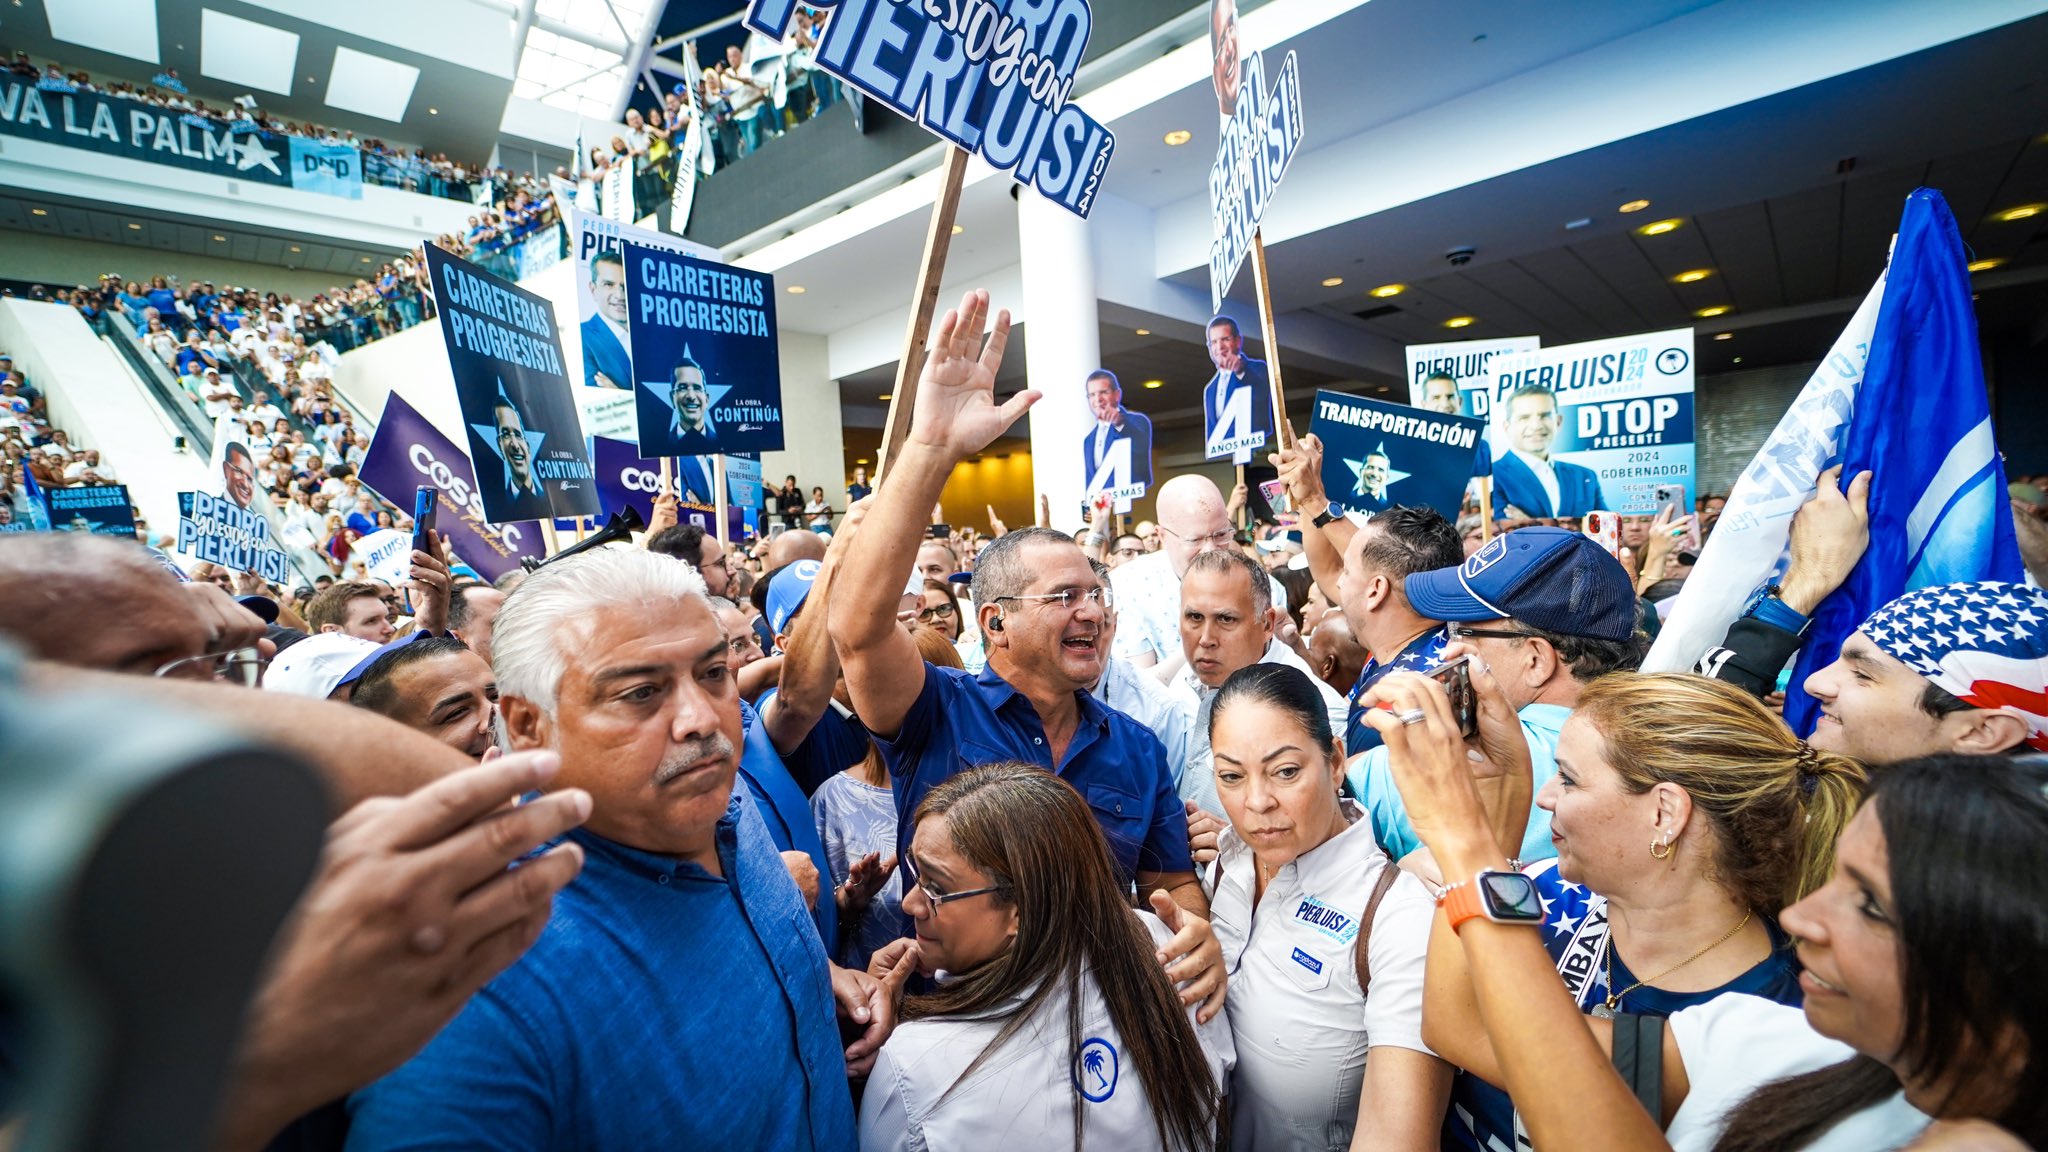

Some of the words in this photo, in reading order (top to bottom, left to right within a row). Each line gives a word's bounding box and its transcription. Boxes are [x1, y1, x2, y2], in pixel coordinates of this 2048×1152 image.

[1020, 51, 1073, 115] CON
[62, 95, 121, 143] LA
[1078, 136, 1113, 214] 2024
[584, 219, 619, 236] PEDRO
[442, 262, 551, 339] CARRETERAS
[641, 257, 764, 307] CARRETERAS
[640, 293, 769, 338] PROGRESISTA
[449, 308, 563, 377] PROGRESISTA
[1630, 347, 1648, 365] 20
[1496, 351, 1627, 403] PIERLUISI
[1627, 364, 1645, 381] 24
[714, 403, 780, 423] CONTINÚA
[1207, 385, 1252, 466] 4
[1319, 400, 1477, 449] TRANSPORTACIÓN
[1578, 397, 1679, 438] DTOP
[1594, 432, 1662, 449] PRESENTE
[1628, 451, 1660, 463] 2024
[537, 458, 592, 480] CONTINÚA
[1601, 464, 1688, 479] GOBERNADOR
[51, 486, 123, 500] CARRETERAS
[52, 496, 127, 510] PROGRESISTA
[196, 491, 269, 542] PEDRO
[179, 517, 285, 585] PIERLUISI
[1295, 900, 1351, 933] PIERLUISI
